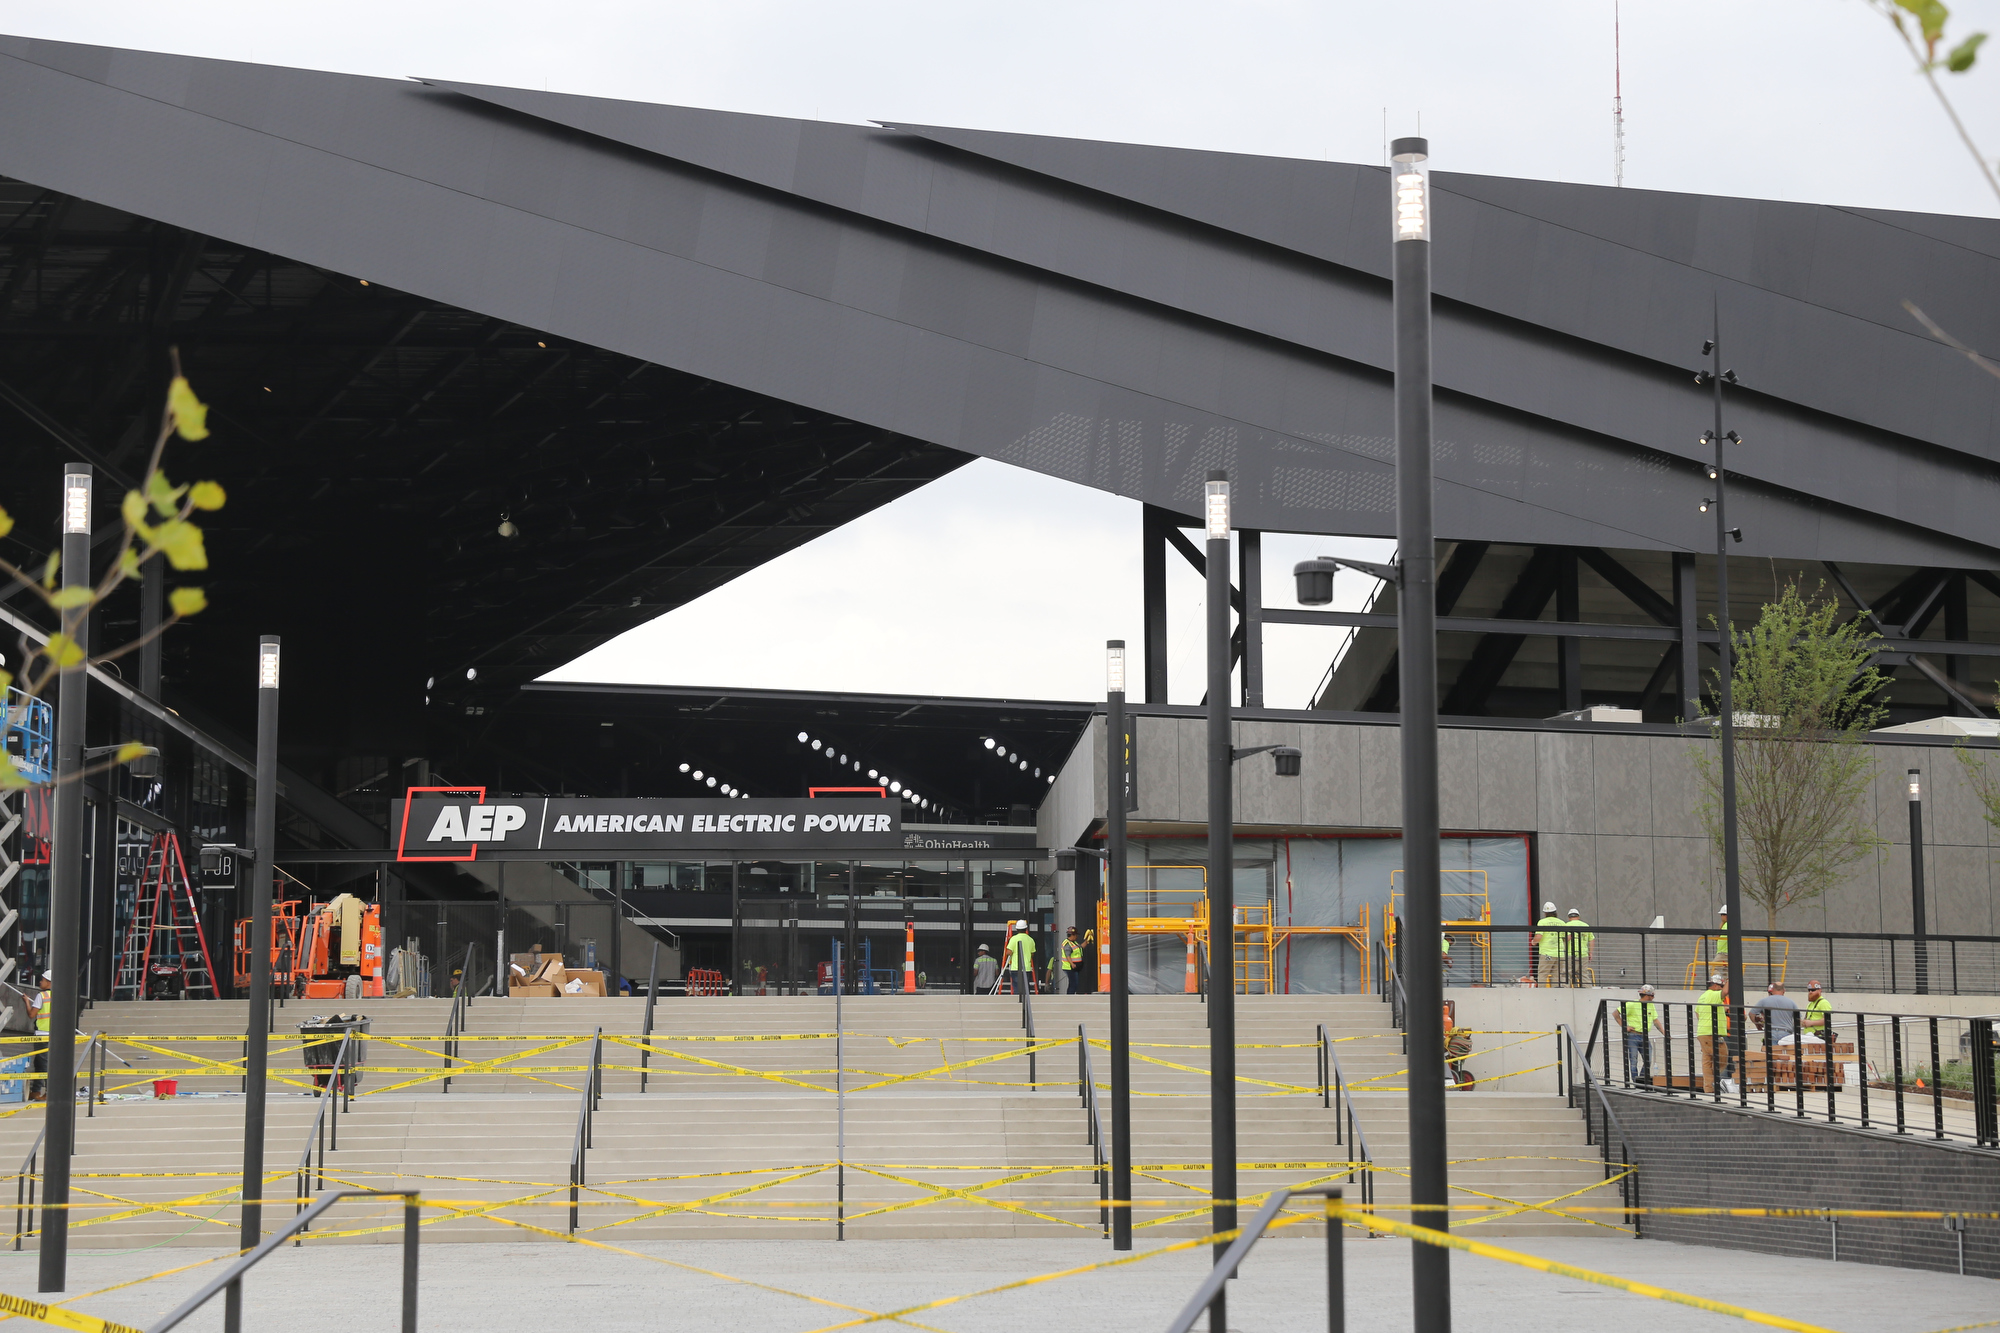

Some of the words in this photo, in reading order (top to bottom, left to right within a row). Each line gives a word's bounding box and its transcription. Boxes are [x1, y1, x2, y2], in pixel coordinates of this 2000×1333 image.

[426, 805, 527, 842] AEP
[553, 814, 684, 832] AMERICAN
[691, 814, 796, 832] ELECTRIC
[803, 814, 892, 832] POWER
[925, 840, 990, 849] OhioHealth
[0, 1293, 48, 1320] CAUTIO
